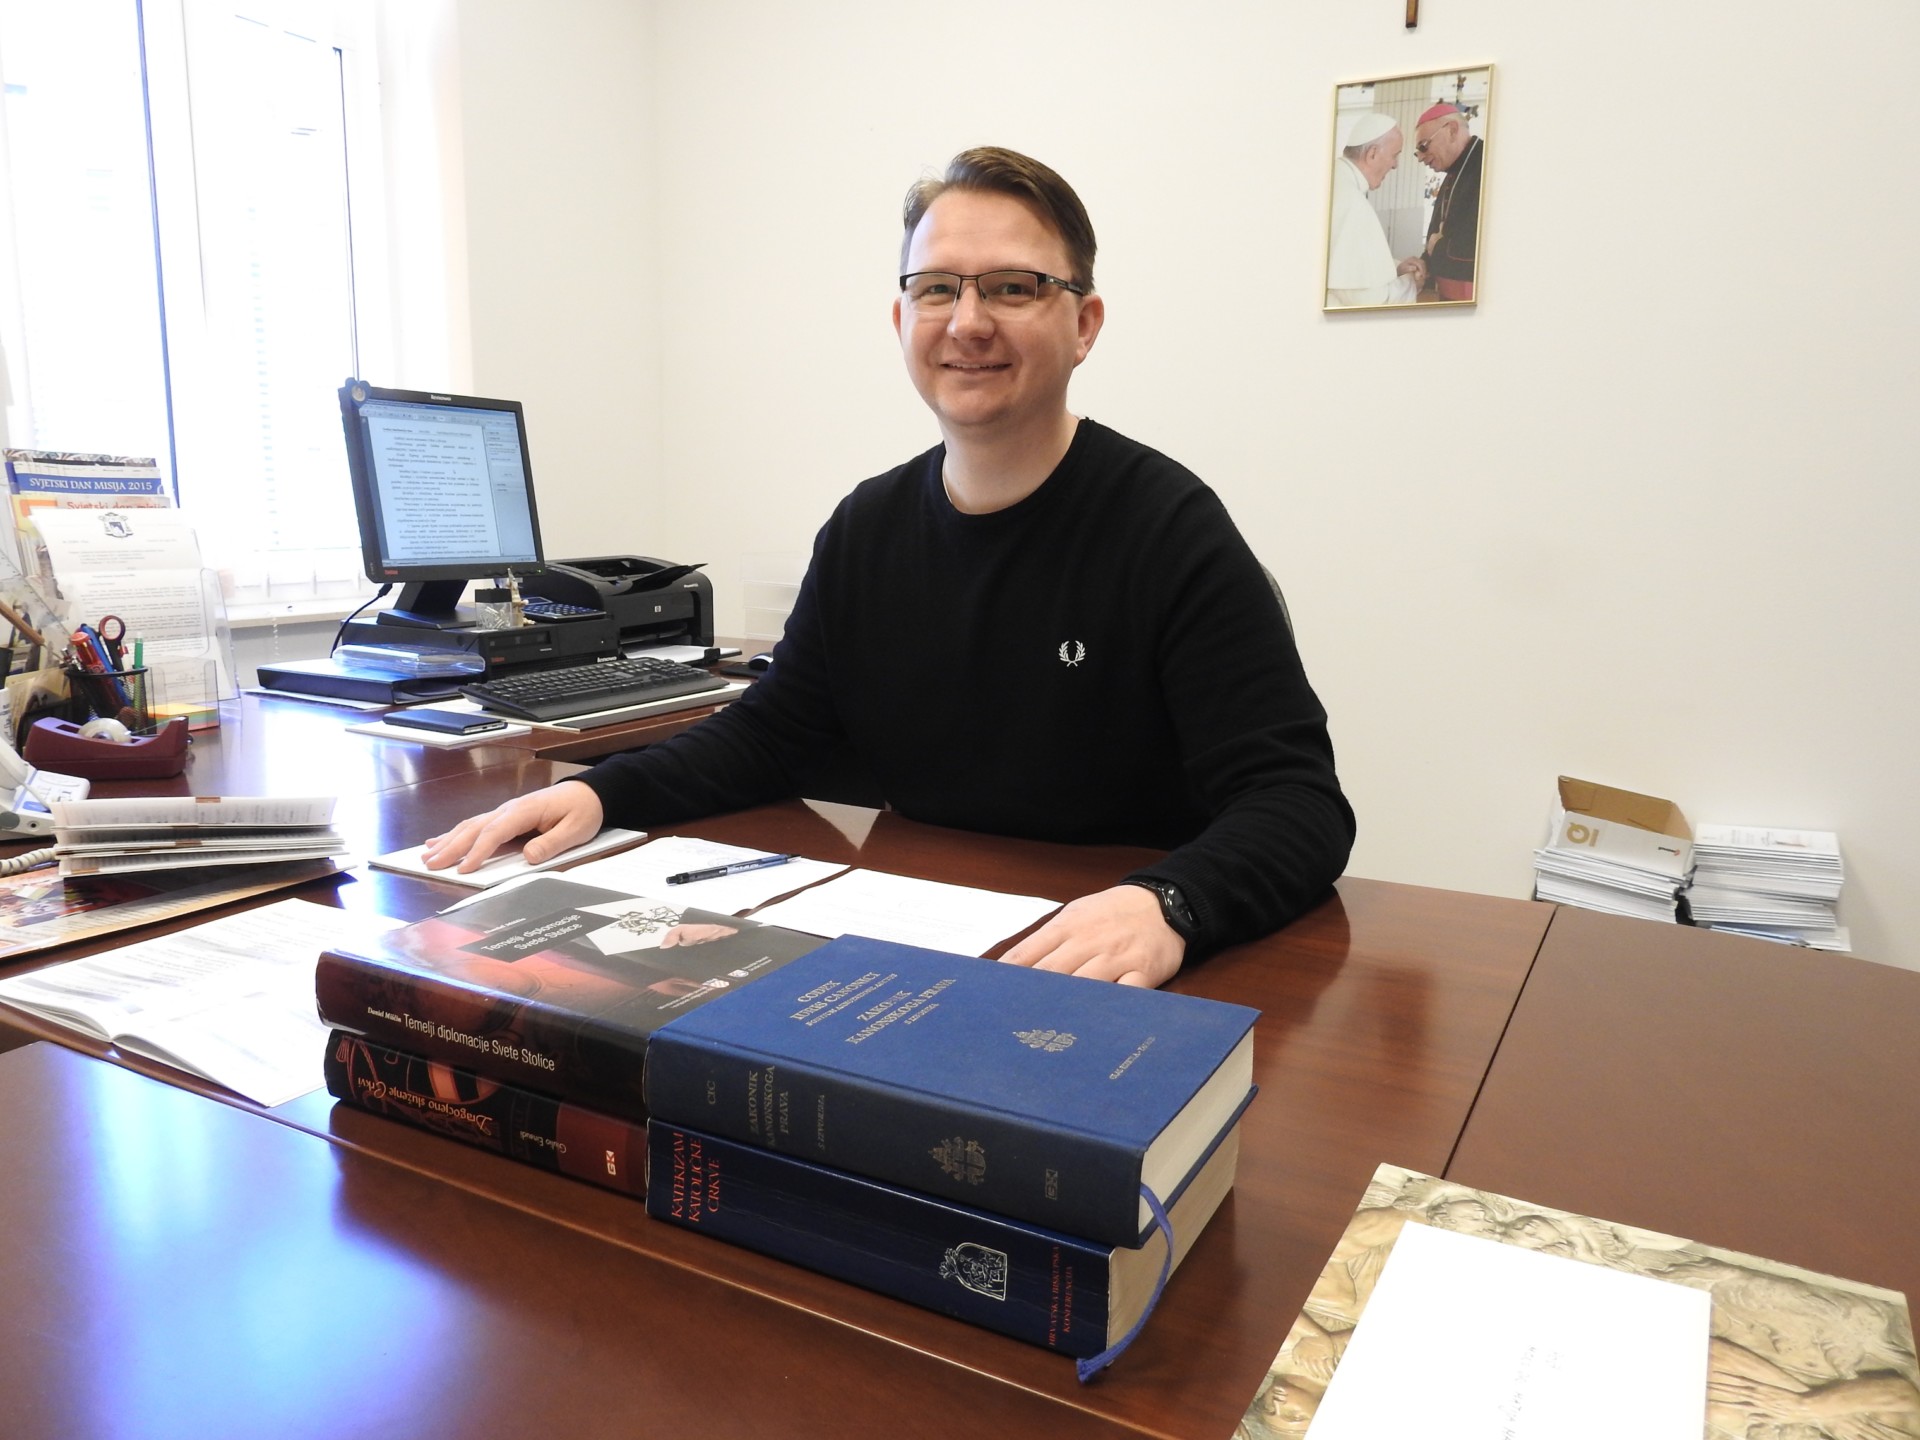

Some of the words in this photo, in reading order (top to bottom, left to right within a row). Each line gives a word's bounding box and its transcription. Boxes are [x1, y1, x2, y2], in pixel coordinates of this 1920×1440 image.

[29, 477, 69, 490] SVJETSKI
[70, 481, 92, 491] DAN
[94, 482, 126, 492] MISIJA
[128, 482, 153, 491] 2015
[481, 935, 525, 951] Temelji
[523, 914, 581, 938] diplomacije
[514, 936, 549, 950] Svete
[545, 923, 583, 939] Stolice
[789, 1001, 828, 1021] IURIS
[824, 971, 881, 1004] CANONICI
[797, 980, 842, 1003] CODEX
[844, 997, 927, 1045] KANONSKOGA
[918, 979, 958, 999] PRAVA
[403, 1013, 436, 1038] Temelji
[437, 1024, 490, 1053] diplomacije
[492, 1039, 519, 1061] Svete
[521, 1048, 556, 1072] Stolice
[357, 1076, 387, 1099] Crkvi
[388, 1086, 426, 1108] služenje
[706, 1080, 716, 1105] CIC
[748, 1069, 759, 1136] ZAKONIK
[763, 1064, 776, 1147] KANONSKOGA
[779, 1090, 789, 1135] PRAVA
[428, 1100, 493, 1136] Dragocjeno
[671, 1131, 685, 1218] KATEKIZAM
[688, 1137, 702, 1222] KATOLIČKE
[707, 1157, 720, 1213] CRKVE
[1048, 1296, 1060, 1347] HRVATSKA
[1062, 1265, 1073, 1334] KONFERENCIJA
